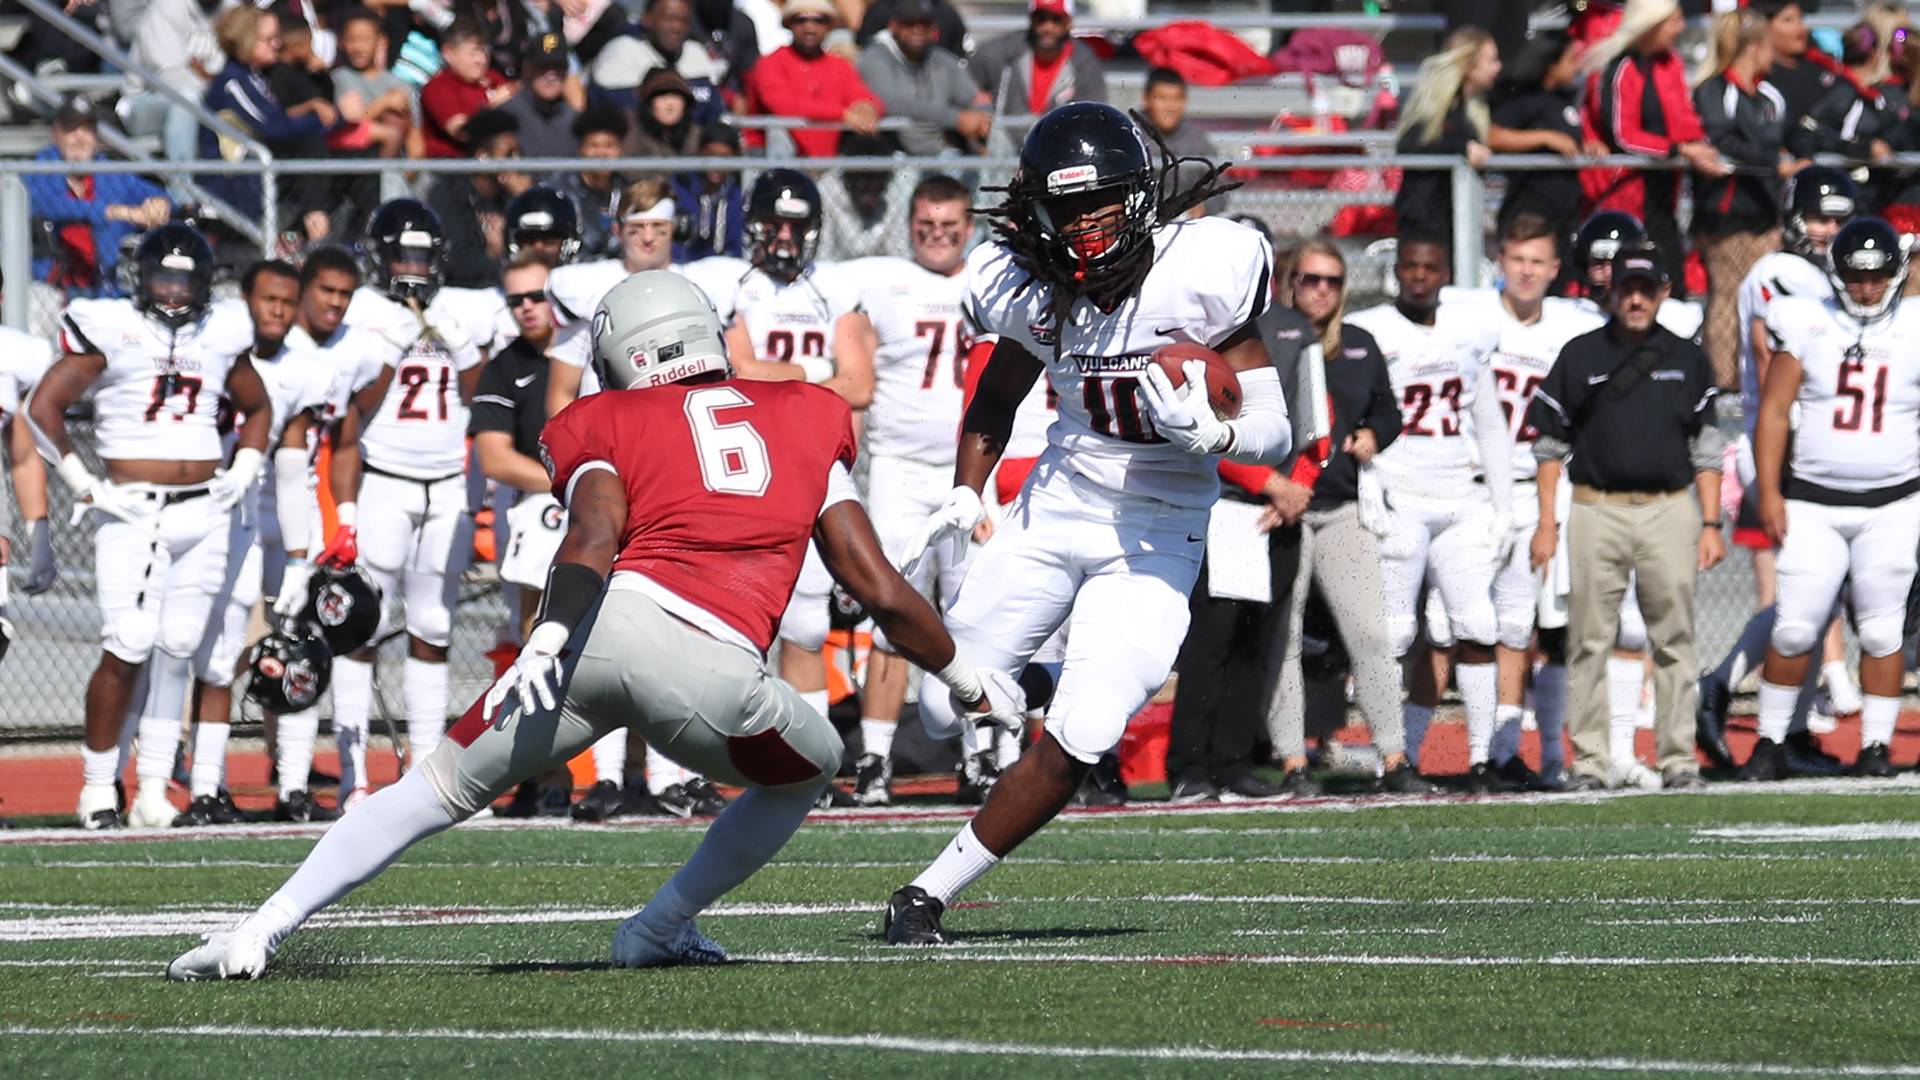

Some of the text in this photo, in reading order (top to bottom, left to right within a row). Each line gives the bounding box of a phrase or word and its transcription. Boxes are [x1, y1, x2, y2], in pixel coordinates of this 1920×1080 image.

[1059, 169, 1085, 180] Riddell
[397, 365, 450, 421] 21
[650, 359, 707, 387] Riddell
[1833, 362, 1889, 433] 51
[1403, 376, 1462, 437] 23
[682, 386, 773, 497] 6
